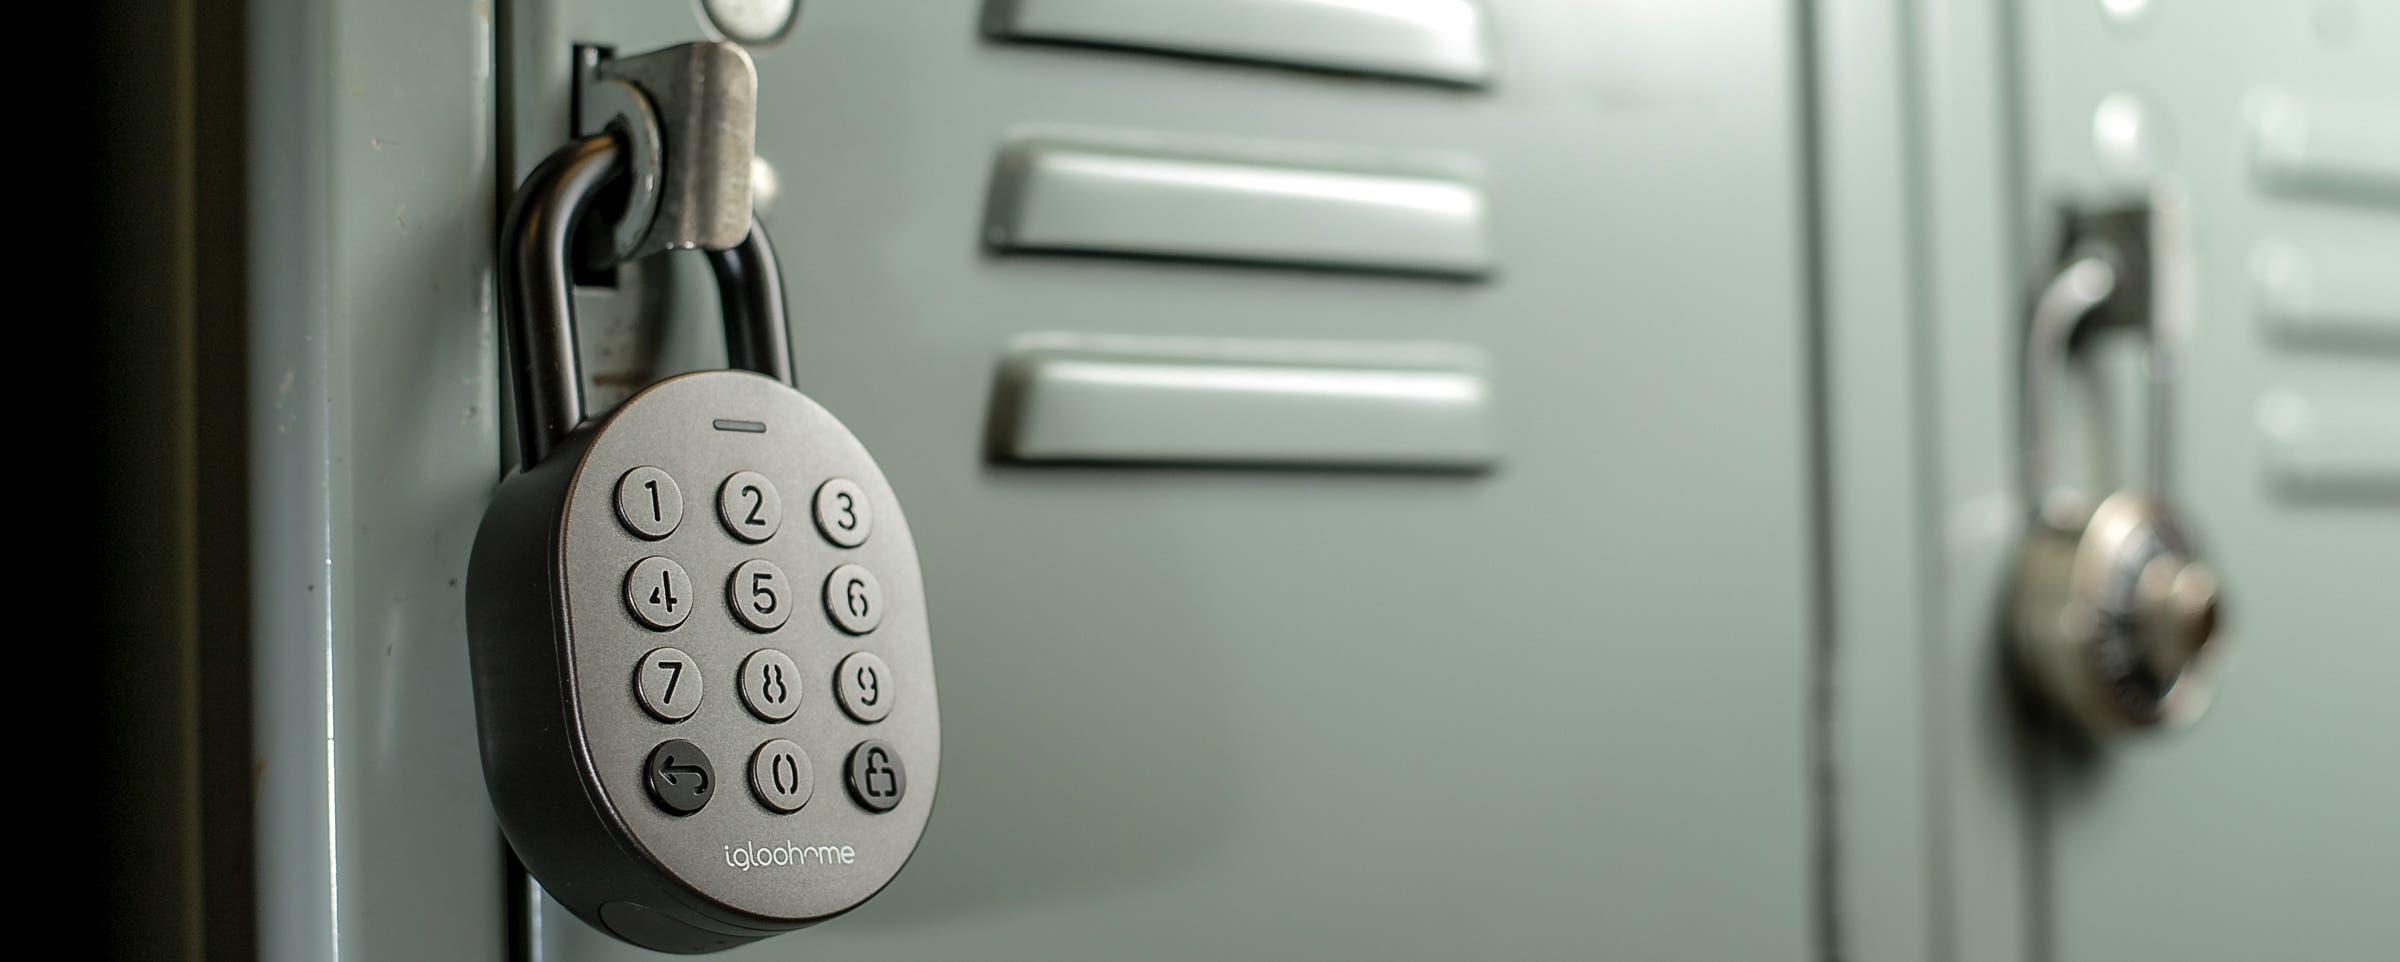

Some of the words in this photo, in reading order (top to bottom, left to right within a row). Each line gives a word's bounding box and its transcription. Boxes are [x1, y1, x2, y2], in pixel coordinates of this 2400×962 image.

[645, 480, 661, 522] 1
[742, 485, 766, 526] 2
[837, 492, 856, 530] 3
[649, 570, 677, 613] 4
[752, 573, 777, 614] 5
[847, 578, 868, 617] 6
[658, 661, 683, 705] 7
[762, 664, 787, 704] 8
[857, 666, 878, 706] 9
[772, 753, 799, 795] 0
[724, 840, 855, 871] igloohome
